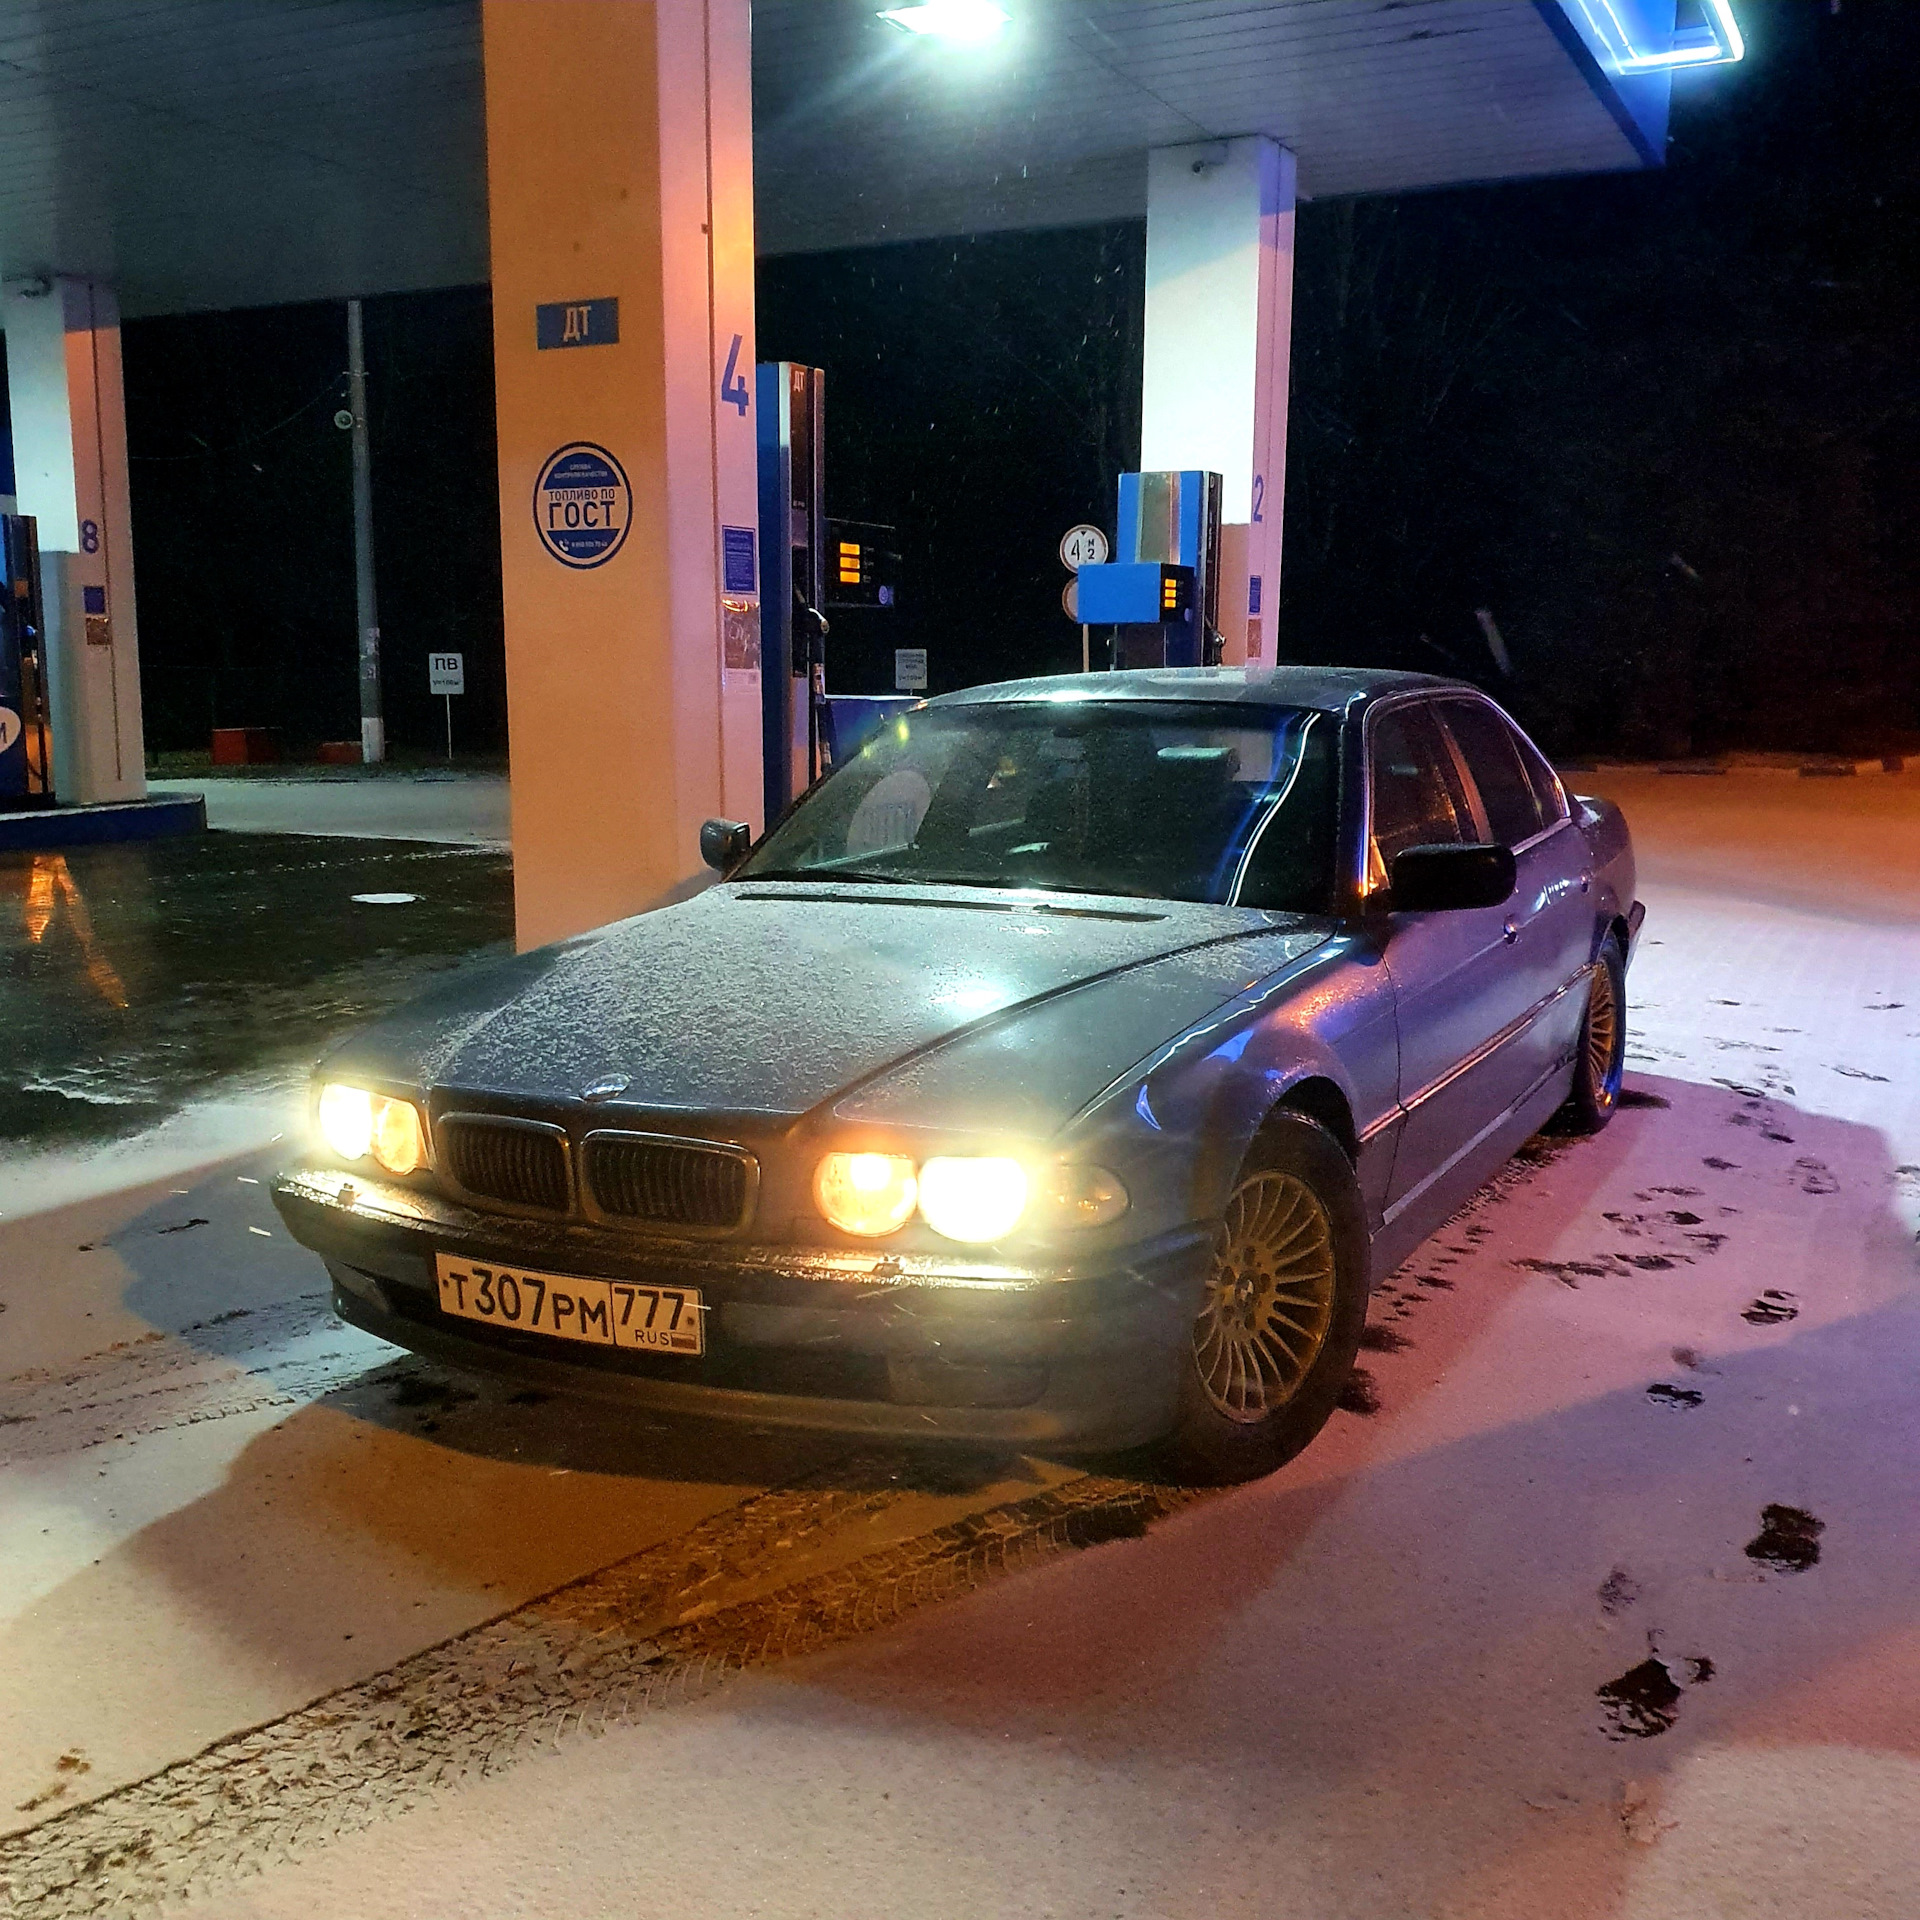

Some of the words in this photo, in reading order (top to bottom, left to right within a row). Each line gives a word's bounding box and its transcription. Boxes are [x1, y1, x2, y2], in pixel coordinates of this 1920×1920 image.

[563, 306, 591, 342] ДТ
[722, 334, 750, 417] 4
[793, 370, 805, 392] ДТ
[549, 490, 598, 501] ТОПЛИВО
[601, 488, 615, 499] ПО
[1253, 475, 1264, 522] 2
[548, 501, 615, 528] ГОСТ
[82, 519, 98, 553] 8
[1071, 539, 1080, 561] 4
[1087, 548, 1095, 560] 2
[435, 658, 458, 670] ПВ
[449, 1267, 609, 1338] Т307РМ
[615, 1287, 685, 1331] 777
[635, 1330, 669, 1346] RUS
